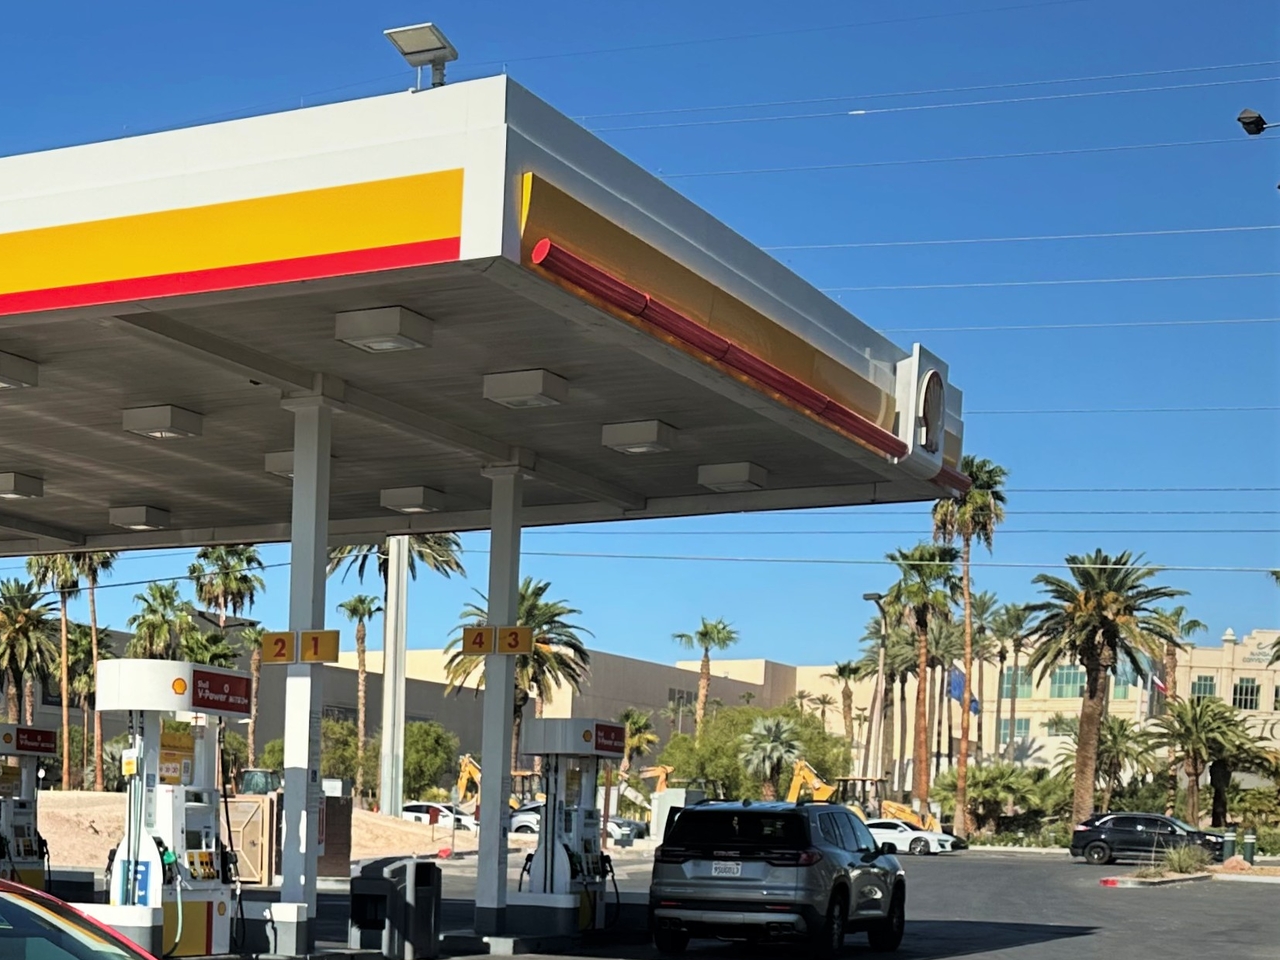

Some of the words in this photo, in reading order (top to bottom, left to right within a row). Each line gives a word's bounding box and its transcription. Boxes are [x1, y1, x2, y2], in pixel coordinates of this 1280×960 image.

[273, 637, 287, 658] 2
[311, 636, 319, 656] 1
[472, 631, 485, 649] 4
[507, 631, 520, 649] 3
[198, 688, 227, 702] V-Power
